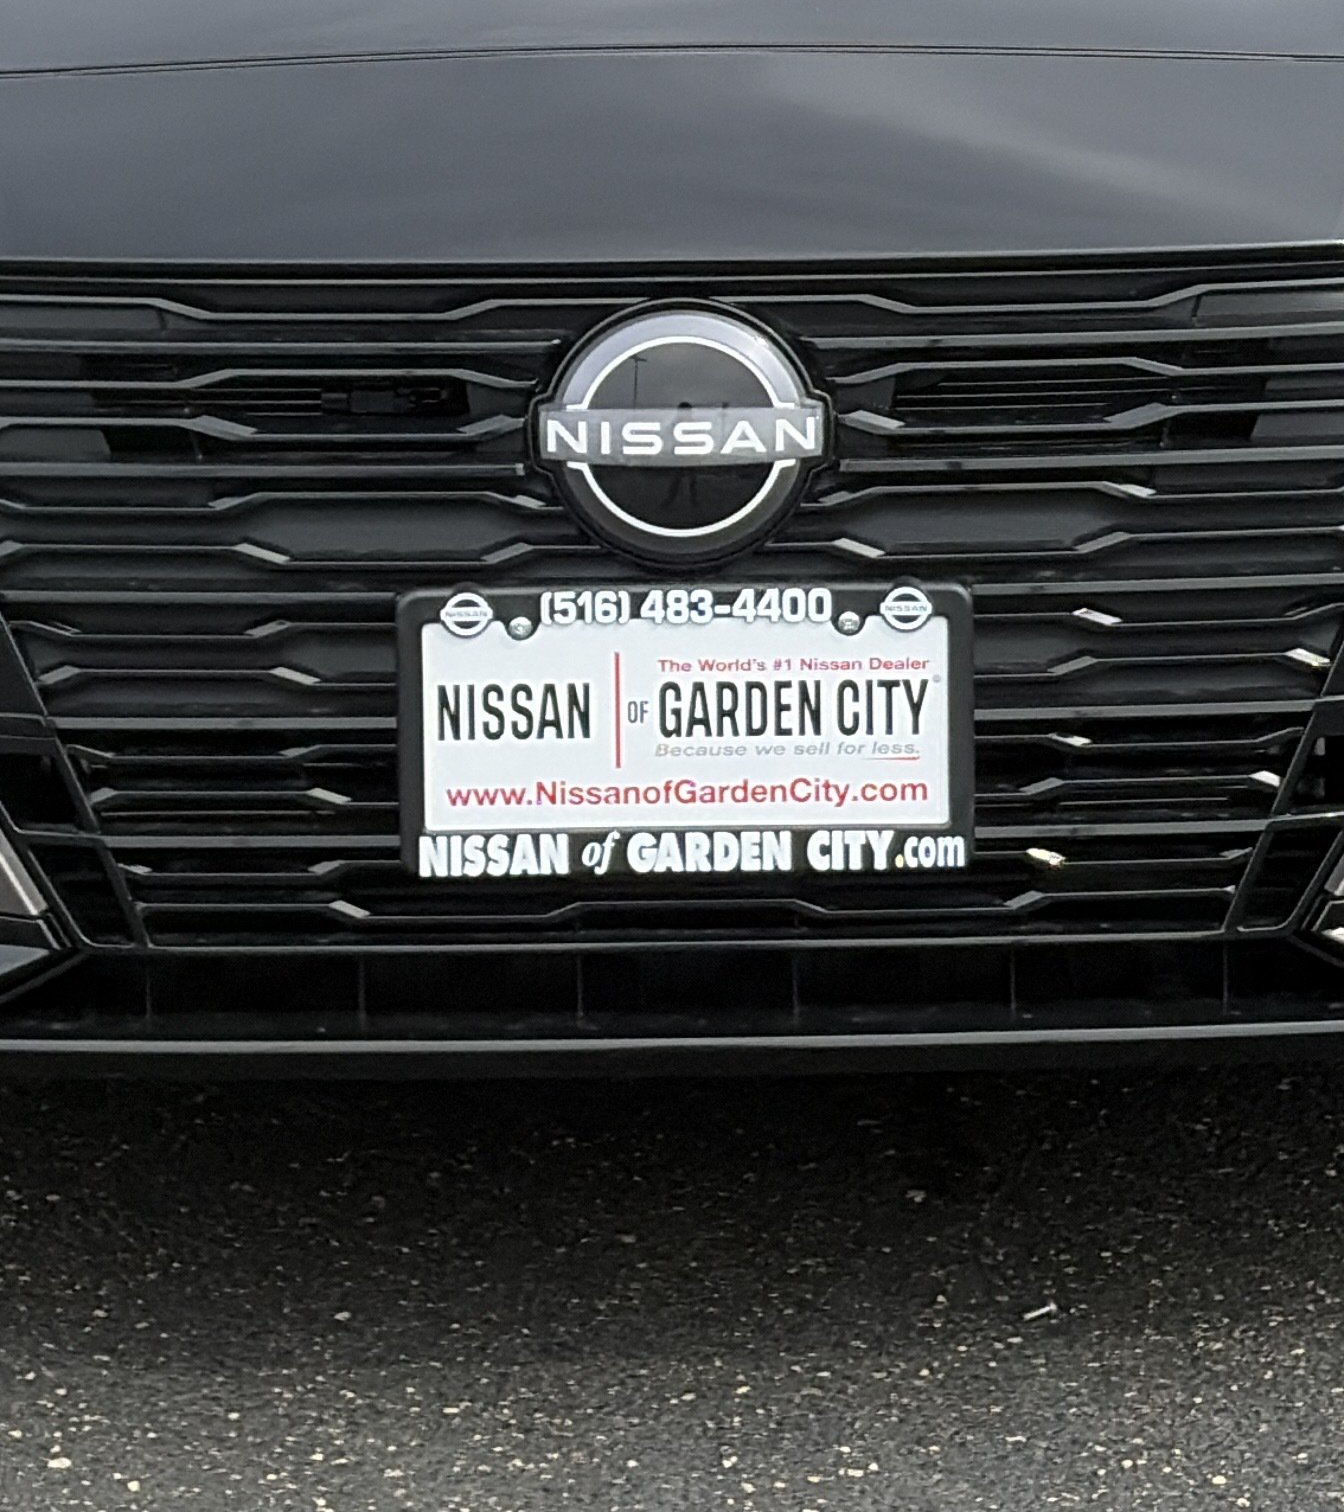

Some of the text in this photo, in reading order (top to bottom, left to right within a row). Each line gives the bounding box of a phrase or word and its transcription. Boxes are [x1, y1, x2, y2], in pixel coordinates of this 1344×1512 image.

[546, 416, 815, 455] NISSAN
[445, 610, 488, 618] NISSAN
[540, 588, 832, 625] (516) 483-4400
[885, 604, 928, 613] NISSAN
[657, 656, 930, 672] The World's #1 Nissan Dealer
[437, 679, 929, 741] NISSAN OF GARDEN CITY
[654, 741, 920, 757] Because we sell for less.
[447, 778, 928, 807] www.NissanofGardenCity.com
[419, 830, 965, 877] NISSAN of GARDEN CITY.com
